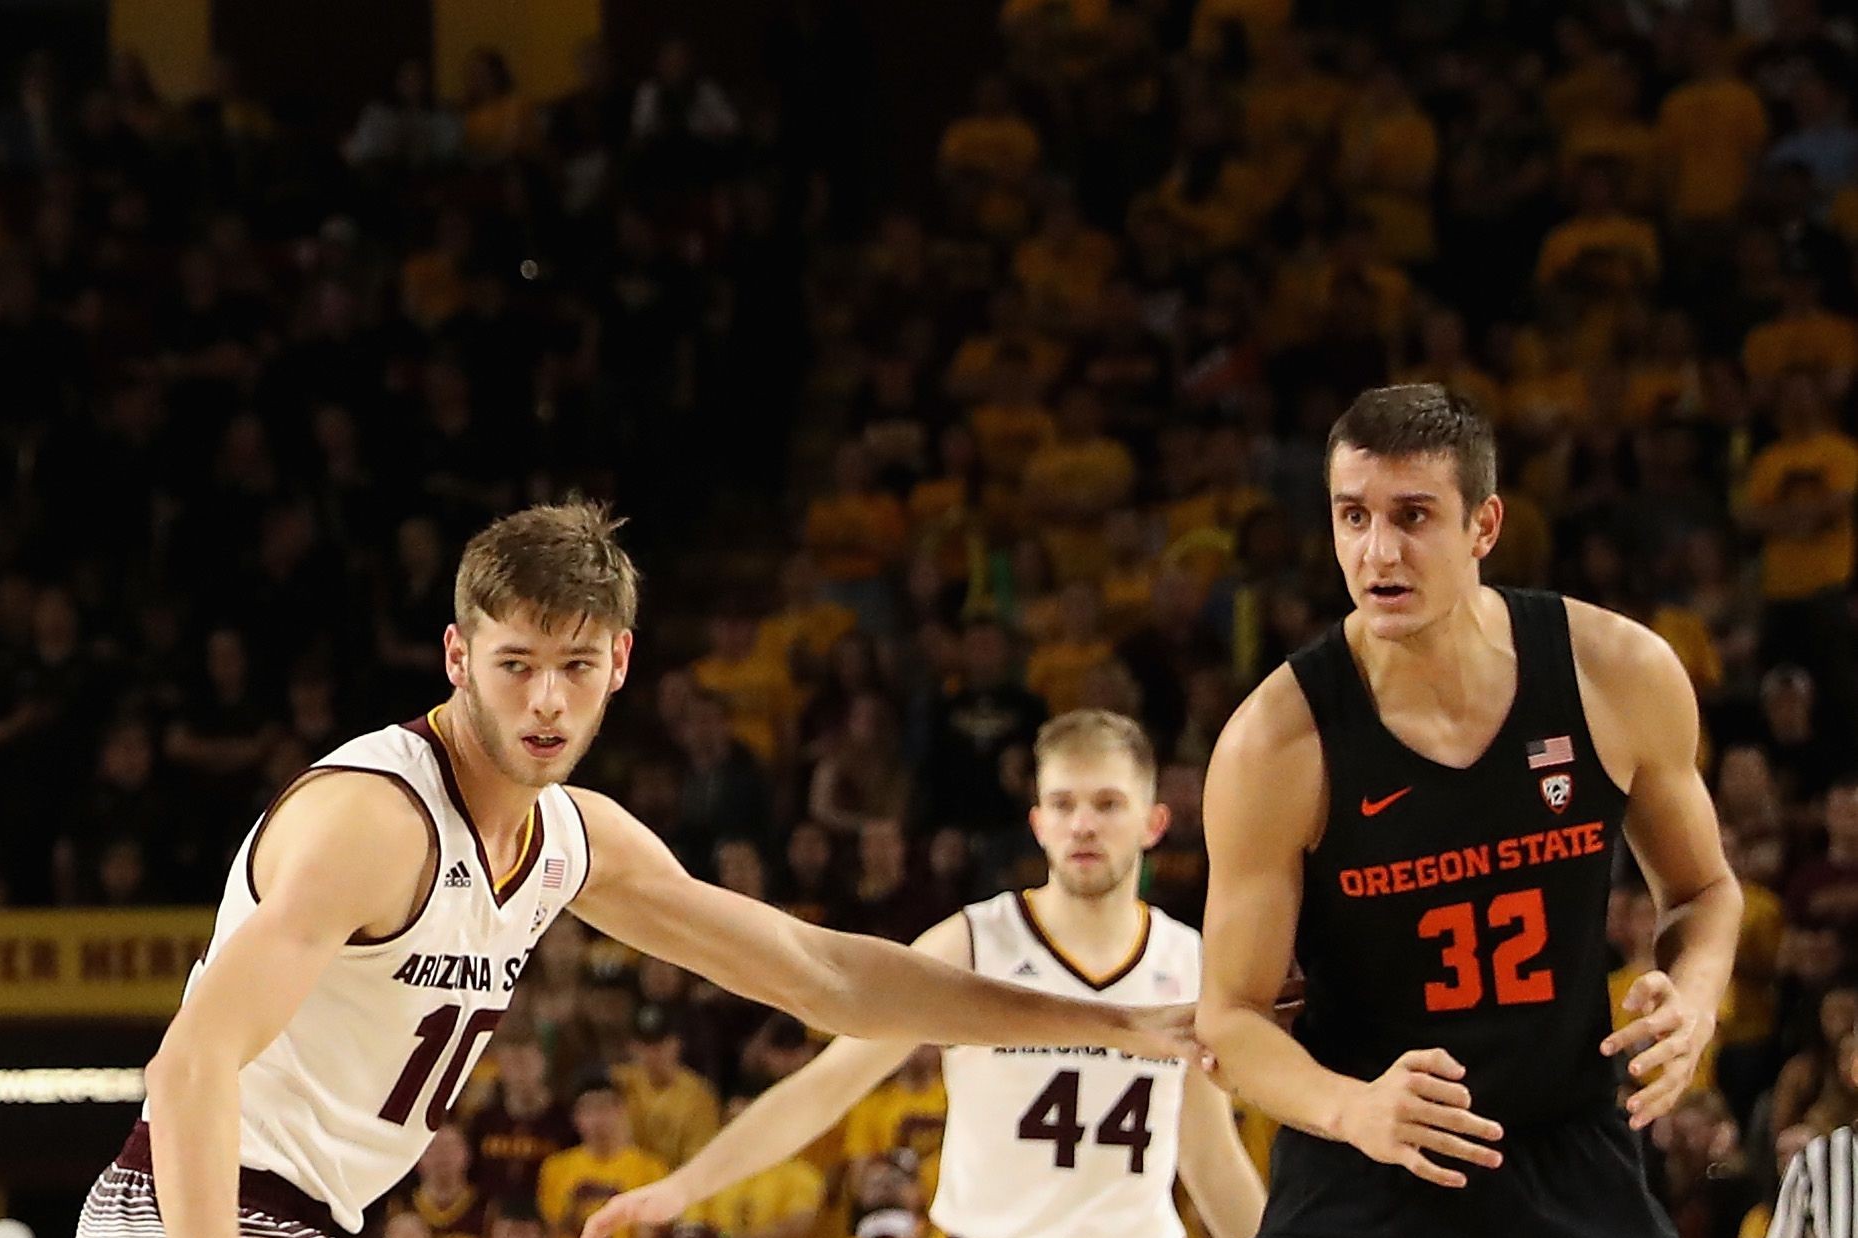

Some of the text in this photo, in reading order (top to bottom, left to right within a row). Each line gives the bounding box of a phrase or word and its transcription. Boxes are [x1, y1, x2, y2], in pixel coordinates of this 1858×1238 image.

[1339, 820, 1605, 898] OREGON STATE
[1417, 888, 1555, 1012] 32
[1018, 1068, 1155, 1175] 44
